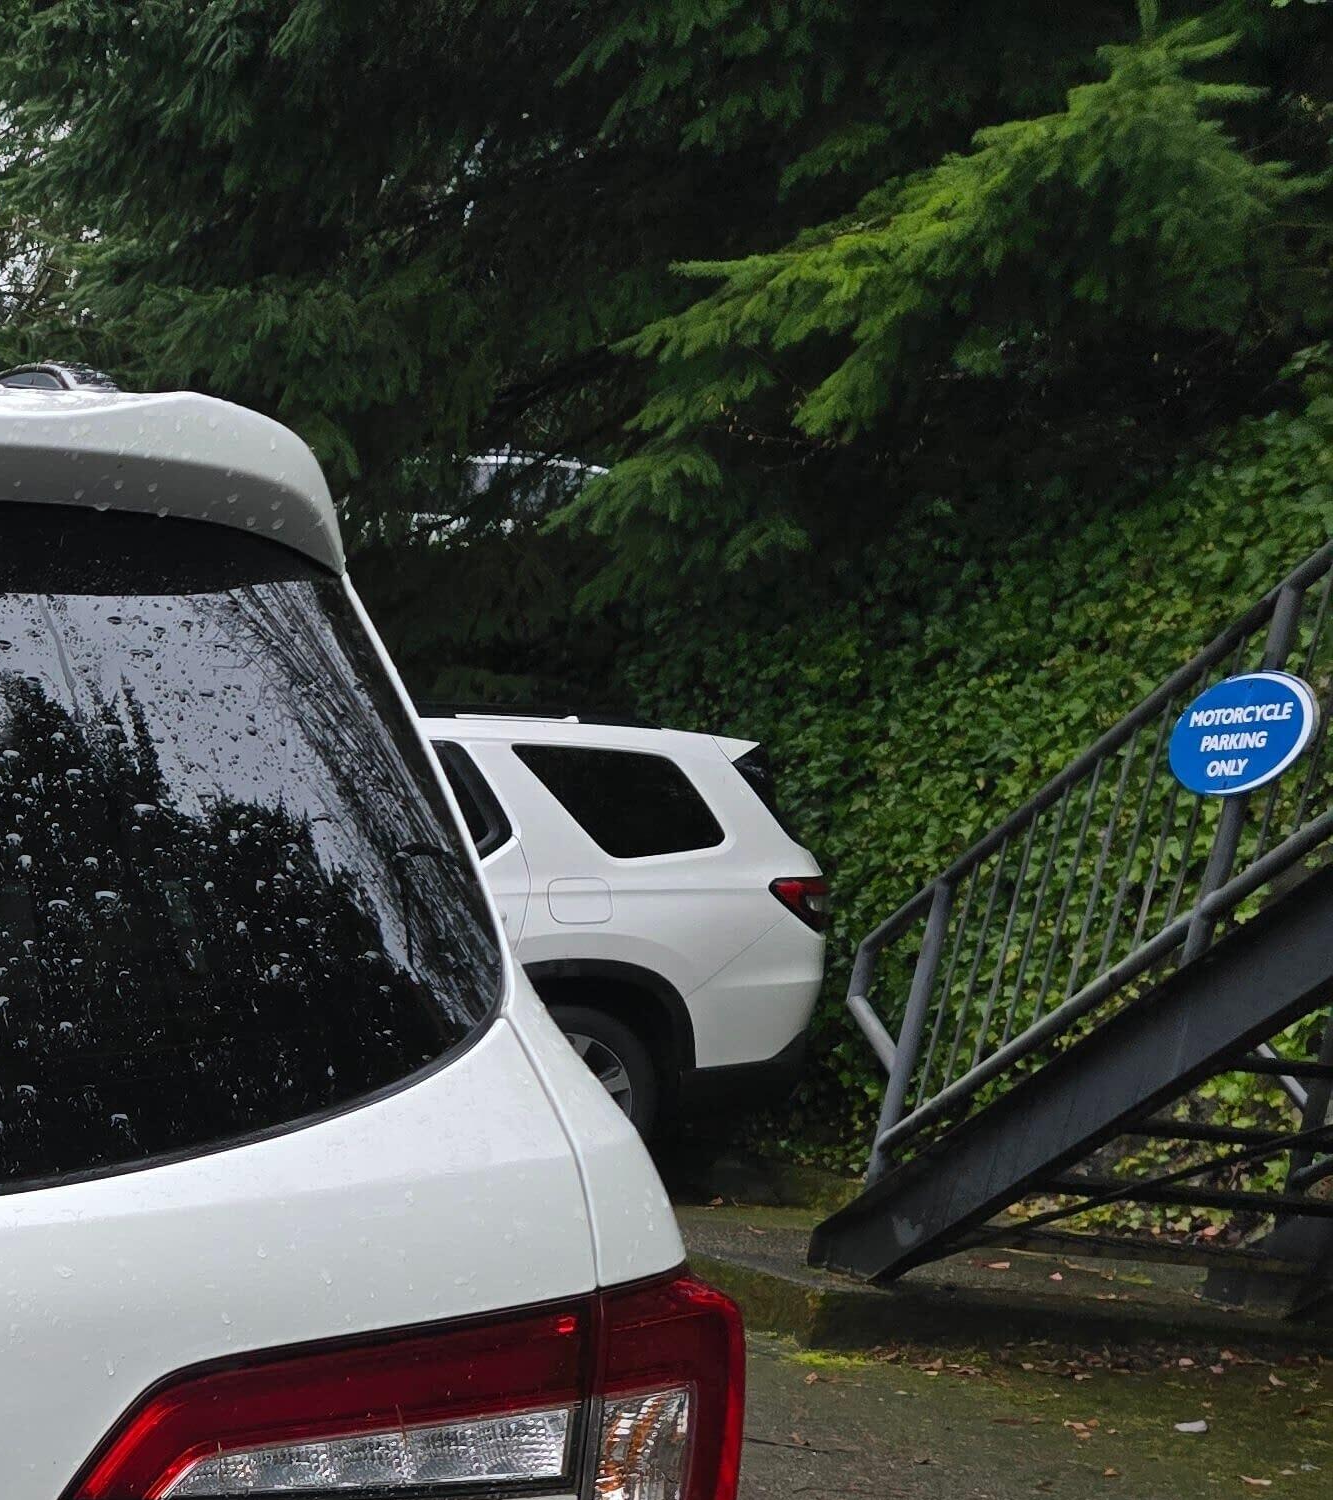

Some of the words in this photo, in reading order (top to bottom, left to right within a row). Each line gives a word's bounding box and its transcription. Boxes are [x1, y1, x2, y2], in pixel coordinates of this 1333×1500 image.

[1189, 702, 1294, 728] MOTORCYCLE
[1200, 731, 1268, 752] PARKING
[1206, 758, 1249, 777] ONLY
